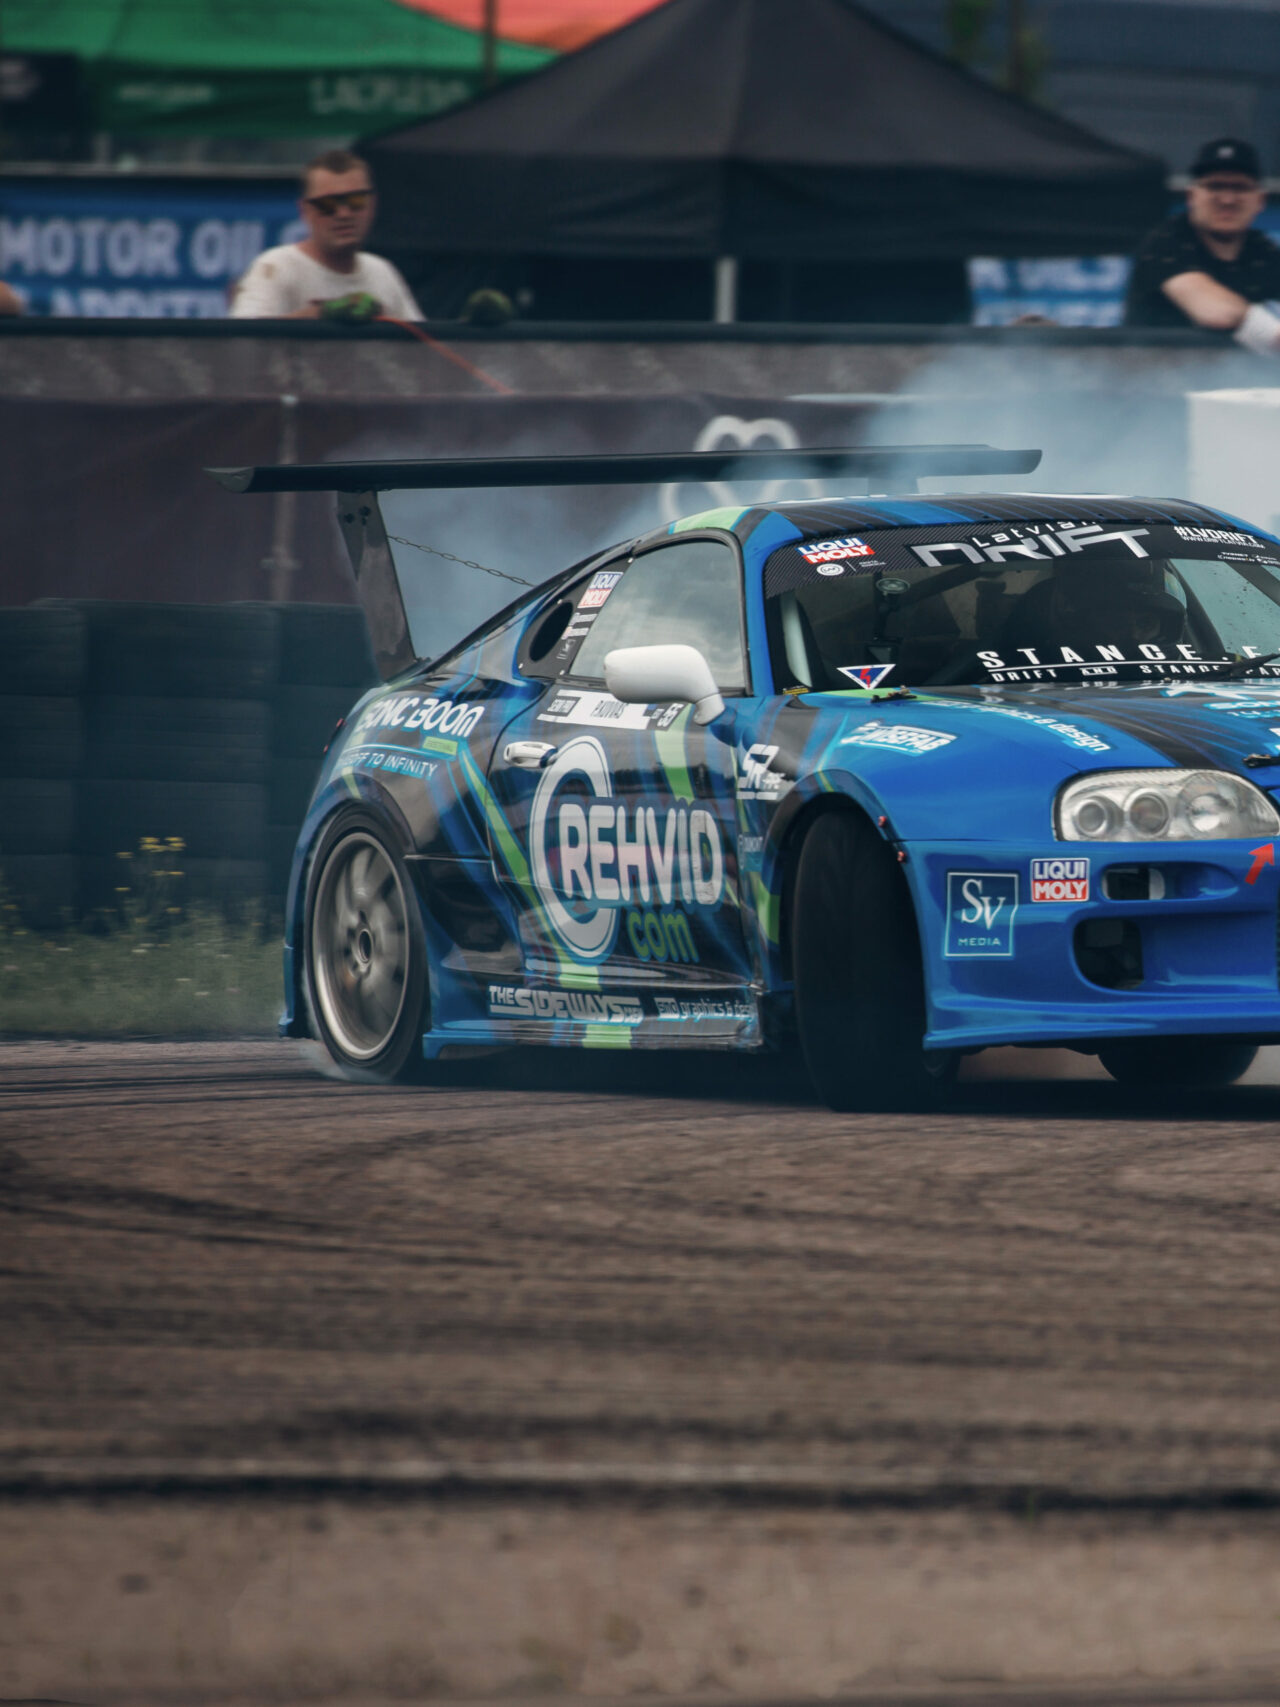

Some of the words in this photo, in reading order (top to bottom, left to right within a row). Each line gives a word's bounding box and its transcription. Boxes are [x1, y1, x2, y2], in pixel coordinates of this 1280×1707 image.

[0, 217, 181, 278] MOTOR
[1174, 526, 1258, 544] #LVDRIFT
[798, 537, 864, 554] LIQUI
[806, 545, 870, 563] MOLY
[910, 524, 1150, 567] DRIFT
[991, 668, 1058, 682] DRIFT
[1050, 721, 1111, 752] design
[367, 752, 385, 766] TO
[384, 754, 438, 778] INFINITY
[558, 803, 724, 905] REHVID
[1034, 861, 1086, 881] LIQUI
[1034, 881, 1087, 900] MOLY
[958, 937, 1001, 946] MEDIA
[489, 985, 515, 1006] THE
[513, 987, 626, 1024] SIDEWAYS
